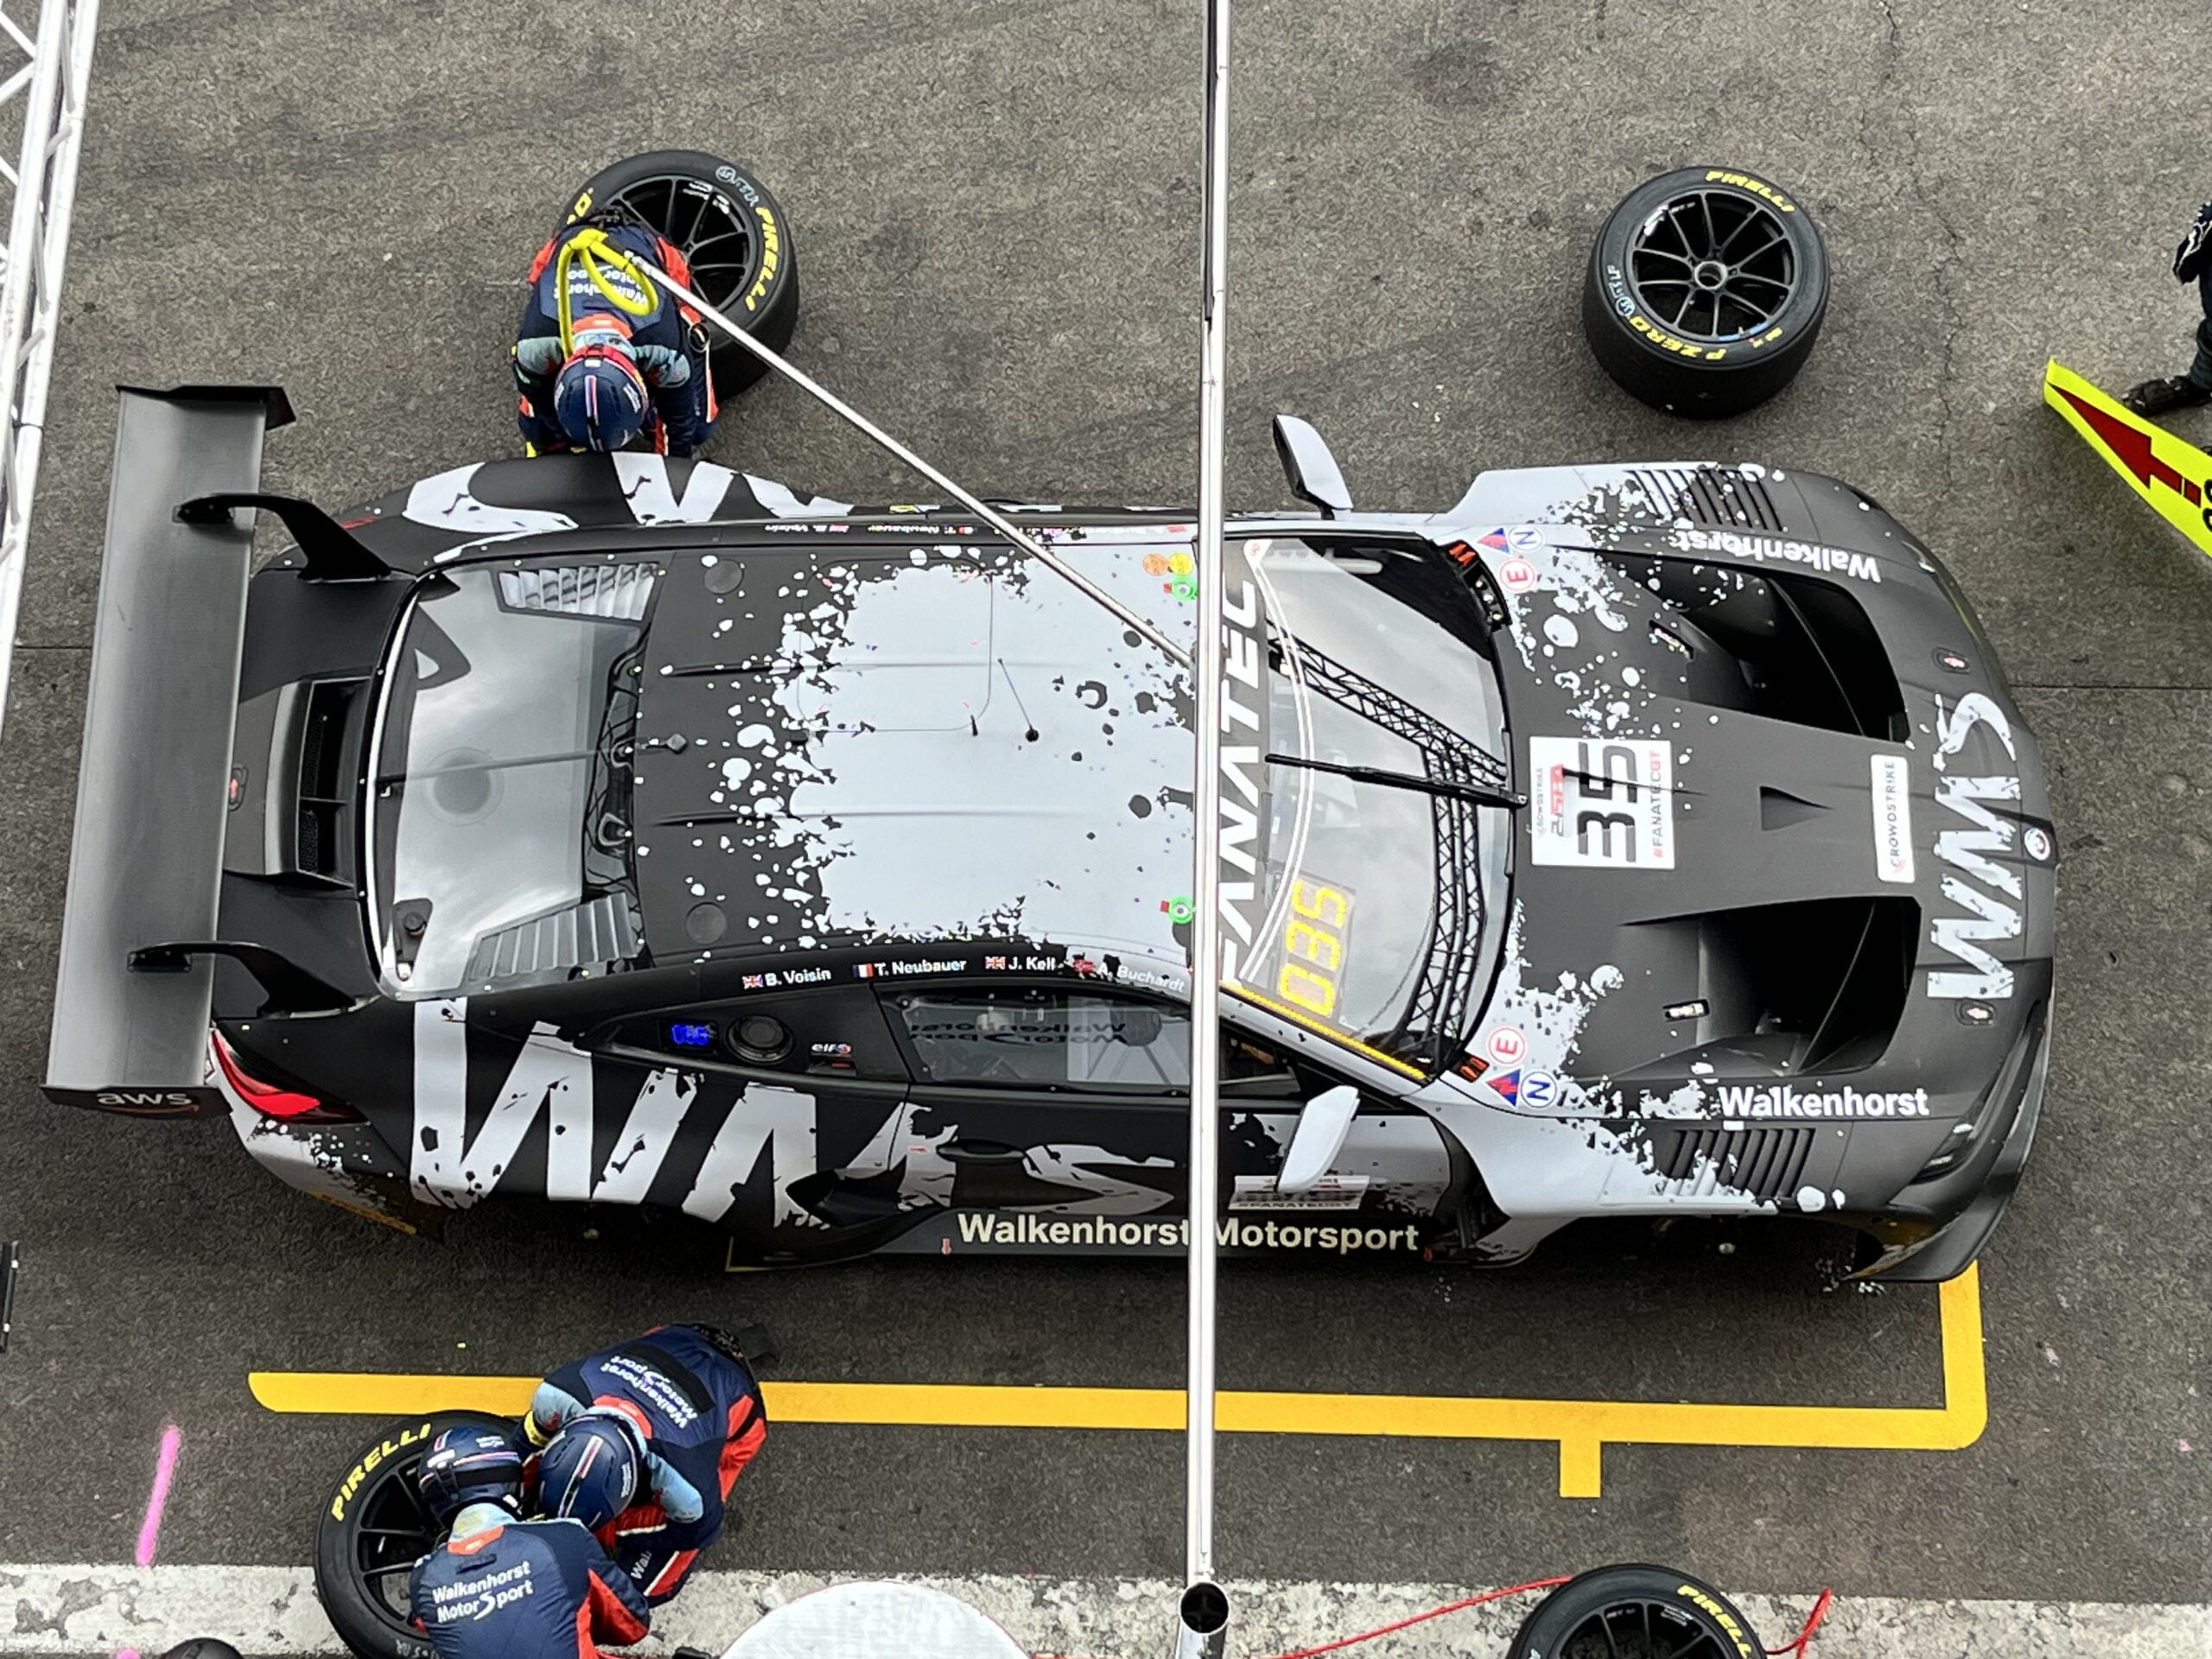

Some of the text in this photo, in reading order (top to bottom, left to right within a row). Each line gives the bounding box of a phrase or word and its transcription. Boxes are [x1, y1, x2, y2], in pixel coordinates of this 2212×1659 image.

[1705, 170, 1796, 212] PIRELLI
[755, 207, 779, 311] PIRELLI
[1630, 316, 1702, 358] ZERO
[1668, 529, 1882, 583] Walkenhorst
[1577, 741, 1637, 863] 35
[874, 958, 967, 976] T. Neubauer
[1277, 880, 1348, 1017] 035
[765, 969, 831, 987] B. Voisin
[1116, 965, 1185, 993] Buchardt
[97, 1091, 192, 1106] aws
[1718, 1086, 1930, 1117] Walkenhorst
[958, 1213, 1420, 1255] Walkenhorst Motorsport
[331, 1422, 431, 1522] PIRELLI
[432, 1560, 531, 1605] Walkenhorst
[436, 1579, 534, 1624] MotorSport
[1676, 1584, 1752, 1659] PIRELL
